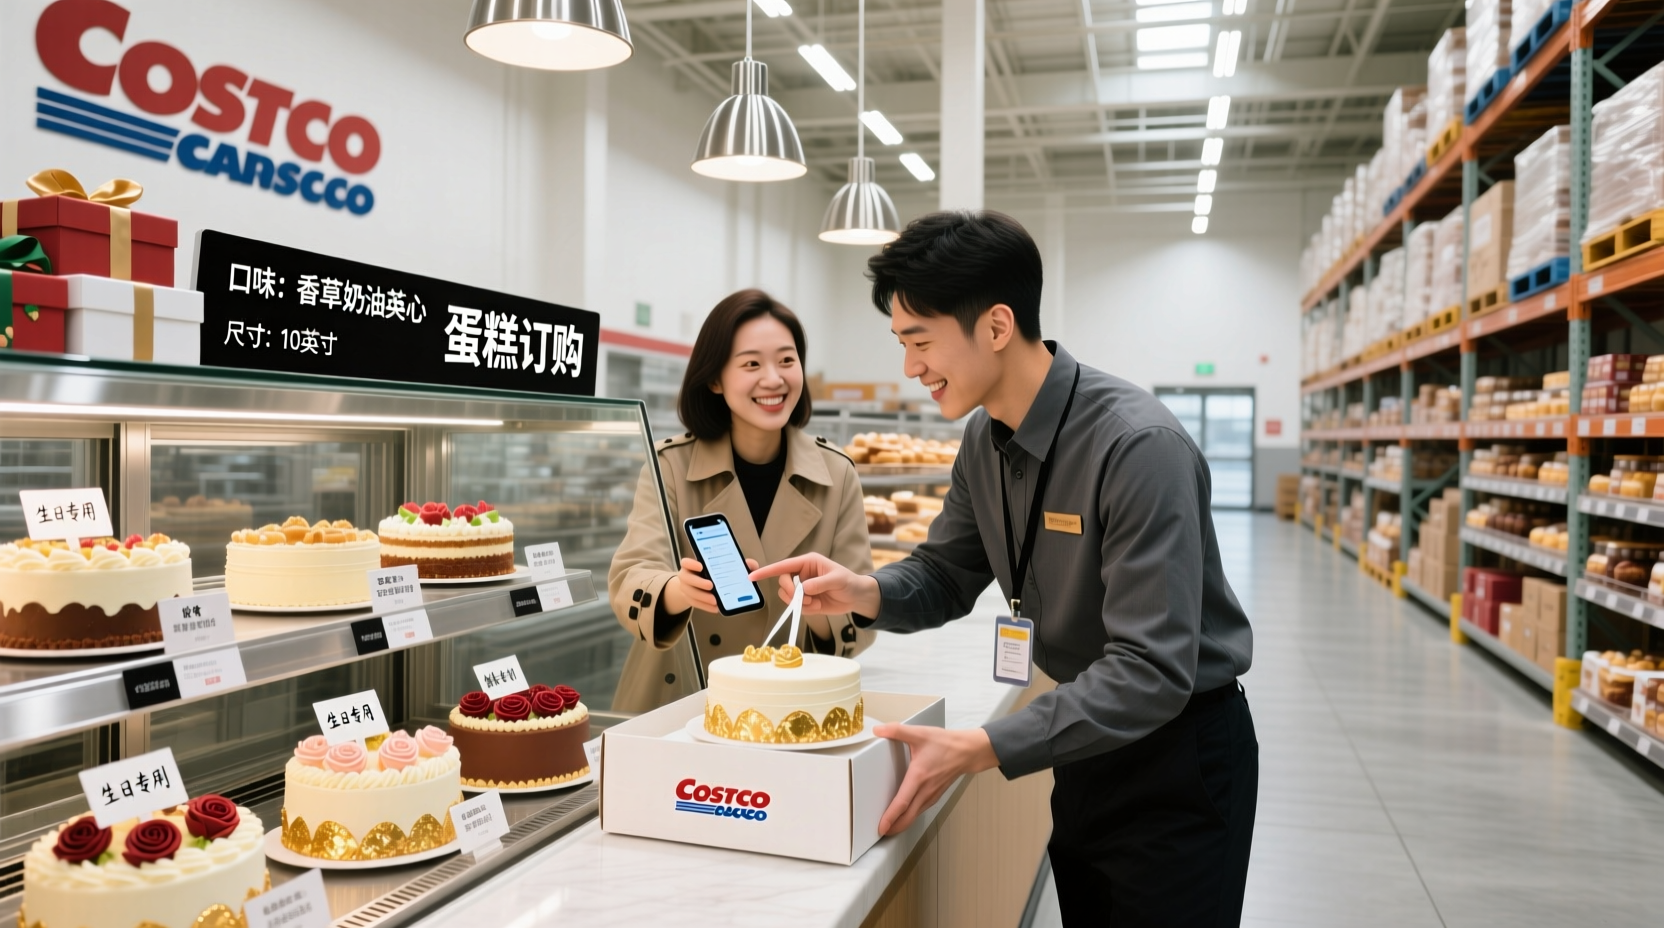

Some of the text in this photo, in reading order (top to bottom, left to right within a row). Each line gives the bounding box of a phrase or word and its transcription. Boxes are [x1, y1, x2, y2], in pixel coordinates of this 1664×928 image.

[444, 304, 584, 378] 蛋糕订购
[36, 502, 96, 524] 生日专用
